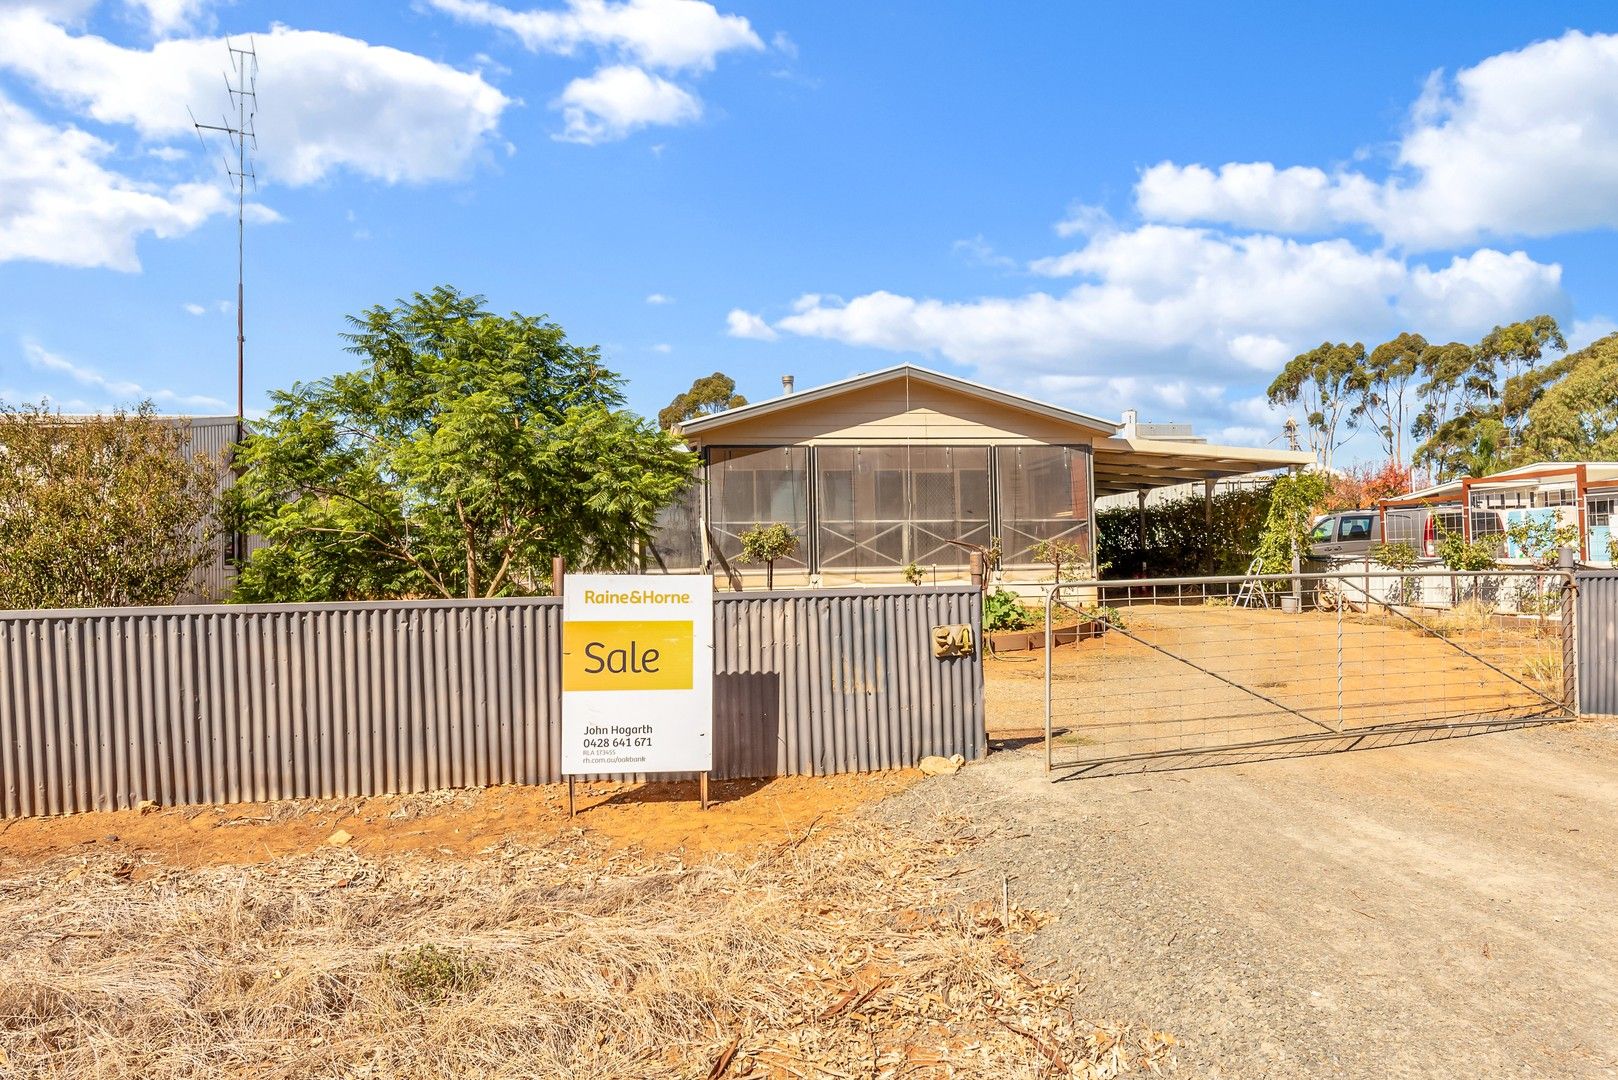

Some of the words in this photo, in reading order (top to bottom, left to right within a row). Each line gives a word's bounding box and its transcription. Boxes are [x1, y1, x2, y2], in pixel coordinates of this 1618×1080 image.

[584, 590, 690, 604] Raine&Horne
[584, 640, 660, 674] Sale
[583, 726, 608, 736] John
[611, 724, 653, 737] Hogarth
[583, 738, 610, 748] 0428
[612, 738, 632, 748] 641
[634, 737, 653, 747] 671
[582, 755, 647, 764] rh.com.au/oakbank
